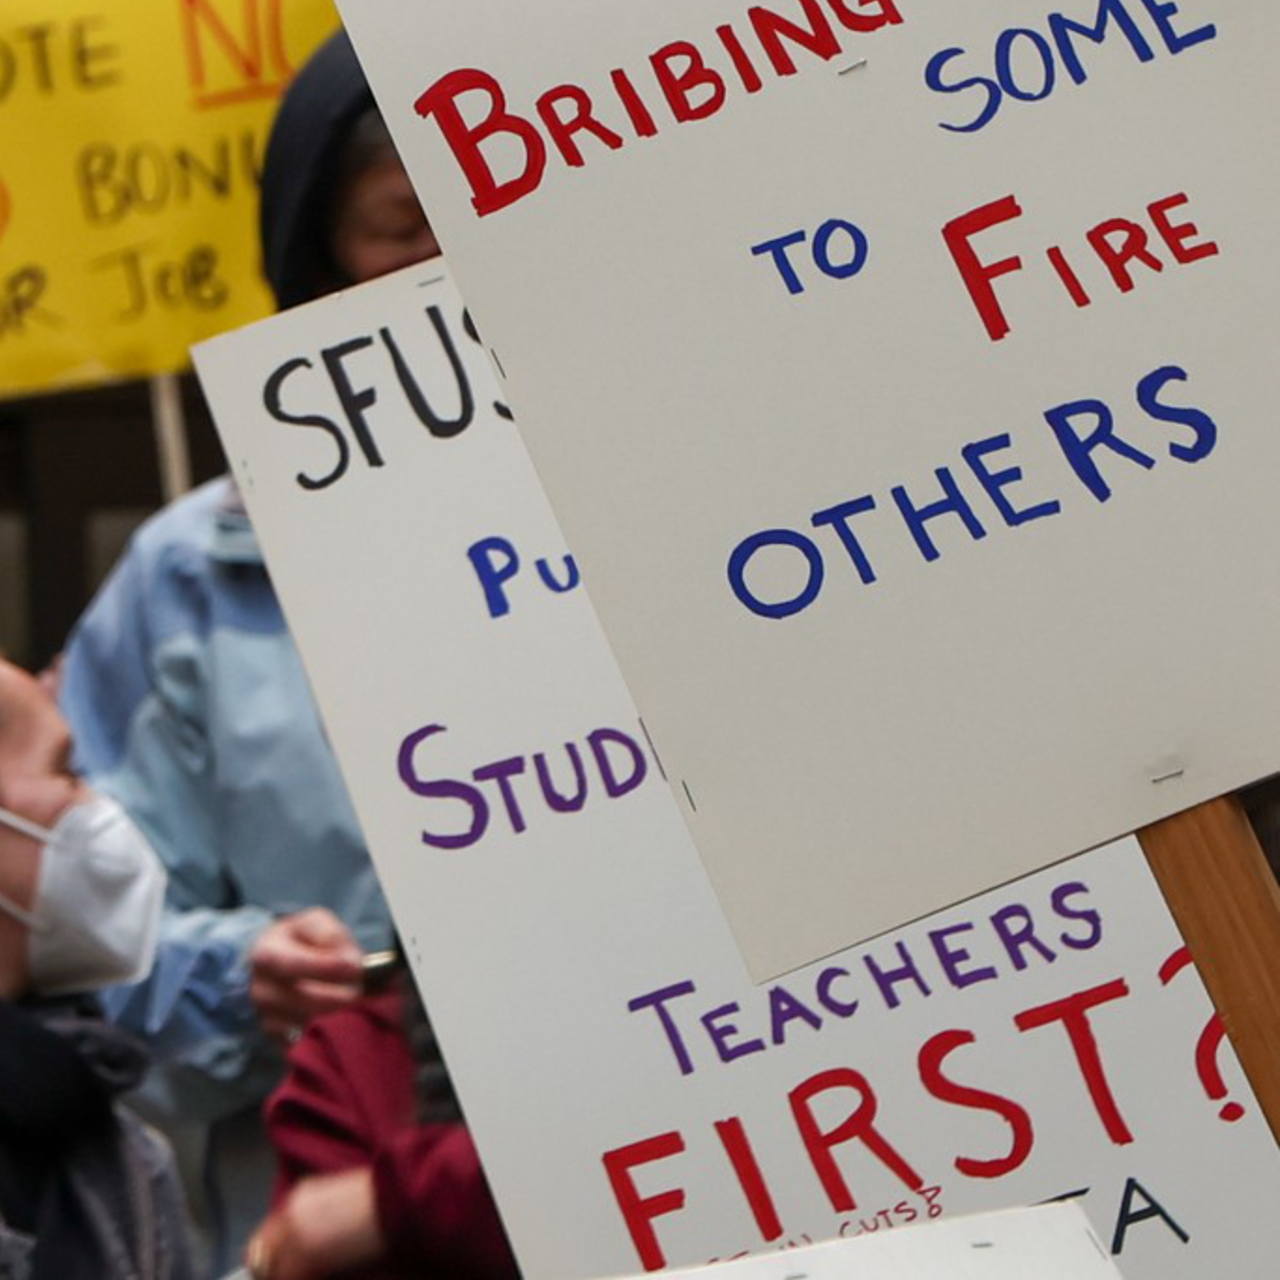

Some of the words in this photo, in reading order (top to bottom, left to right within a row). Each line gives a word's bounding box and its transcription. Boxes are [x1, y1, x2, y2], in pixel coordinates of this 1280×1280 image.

[78, 130, 261, 226] BON
[751, 219, 868, 295] TO
[941, 193, 1218, 341] FIRE
[88, 242, 231, 322] JOB
[263, 305, 514, 490] SFU
[727, 366, 1217, 619] OTHERS
[628, 881, 1103, 1075] TEACHERS
[601, 944, 1247, 1272] FIRST?
